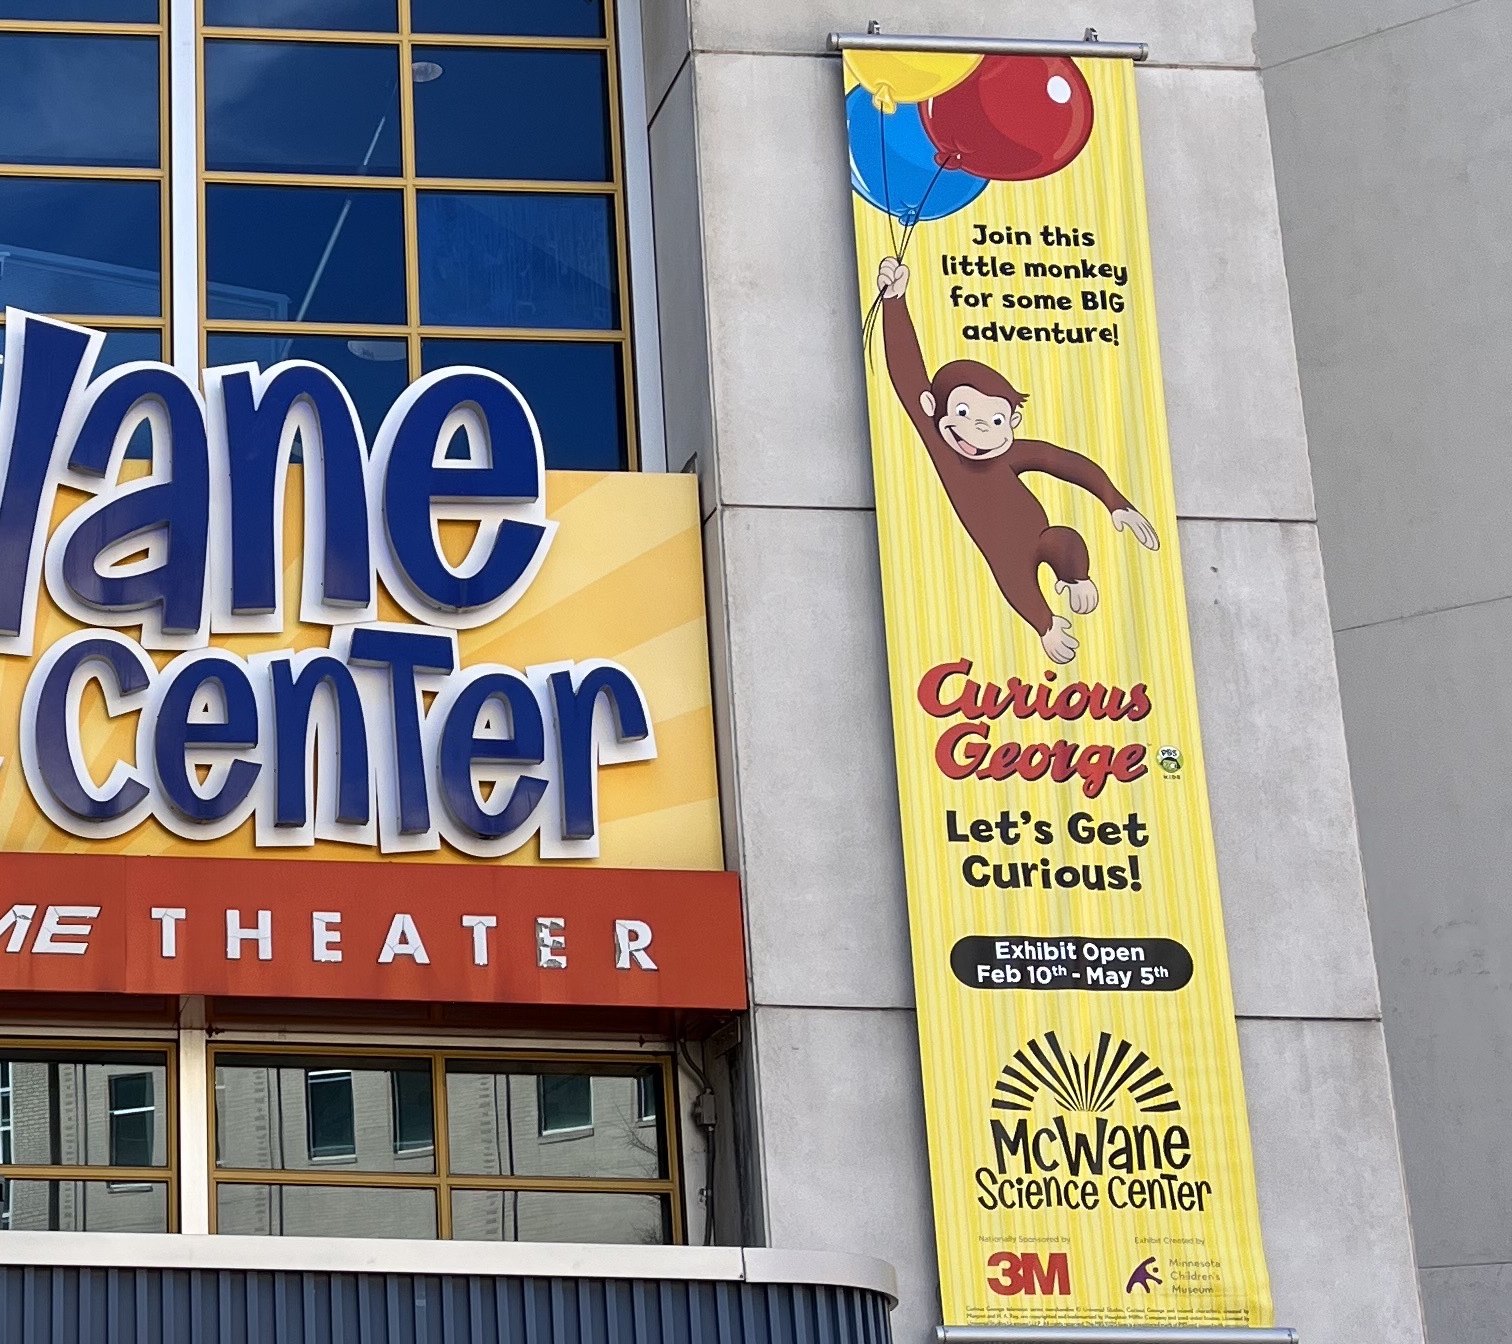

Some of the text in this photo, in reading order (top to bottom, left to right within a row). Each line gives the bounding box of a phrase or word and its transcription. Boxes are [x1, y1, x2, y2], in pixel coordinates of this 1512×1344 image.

[971, 223, 1096, 248] Join this
[941, 255, 1128, 286] little monkey
[950, 286, 1125, 314] for some BIG
[962, 319, 1120, 346] adventure!
[917, 658, 1152, 722] Curious
[934, 721, 1149, 800] George
[1067, 811, 1149, 849] Get
[961, 855, 1142, 891] Curious!
[149, 905, 659, 972] THEATER
[995, 941, 1145, 965] Exhibit Open
[977, 964, 1023, 984] Feb
[1027, 964, 1068, 985] 10th
[1086, 966, 1136, 989] May
[1140, 965, 1169, 987] 5th
[990, 1114, 1190, 1176] McWane
[975, 1166, 1099, 1211] Science
[1061, 1236, 1070, 1244] by
[1195, 1237, 1205, 1245] by
[987, 1251, 1071, 1296] 3M
[1169, 1258, 1221, 1268] Minnesota
[1172, 1284, 1214, 1294] Museum
